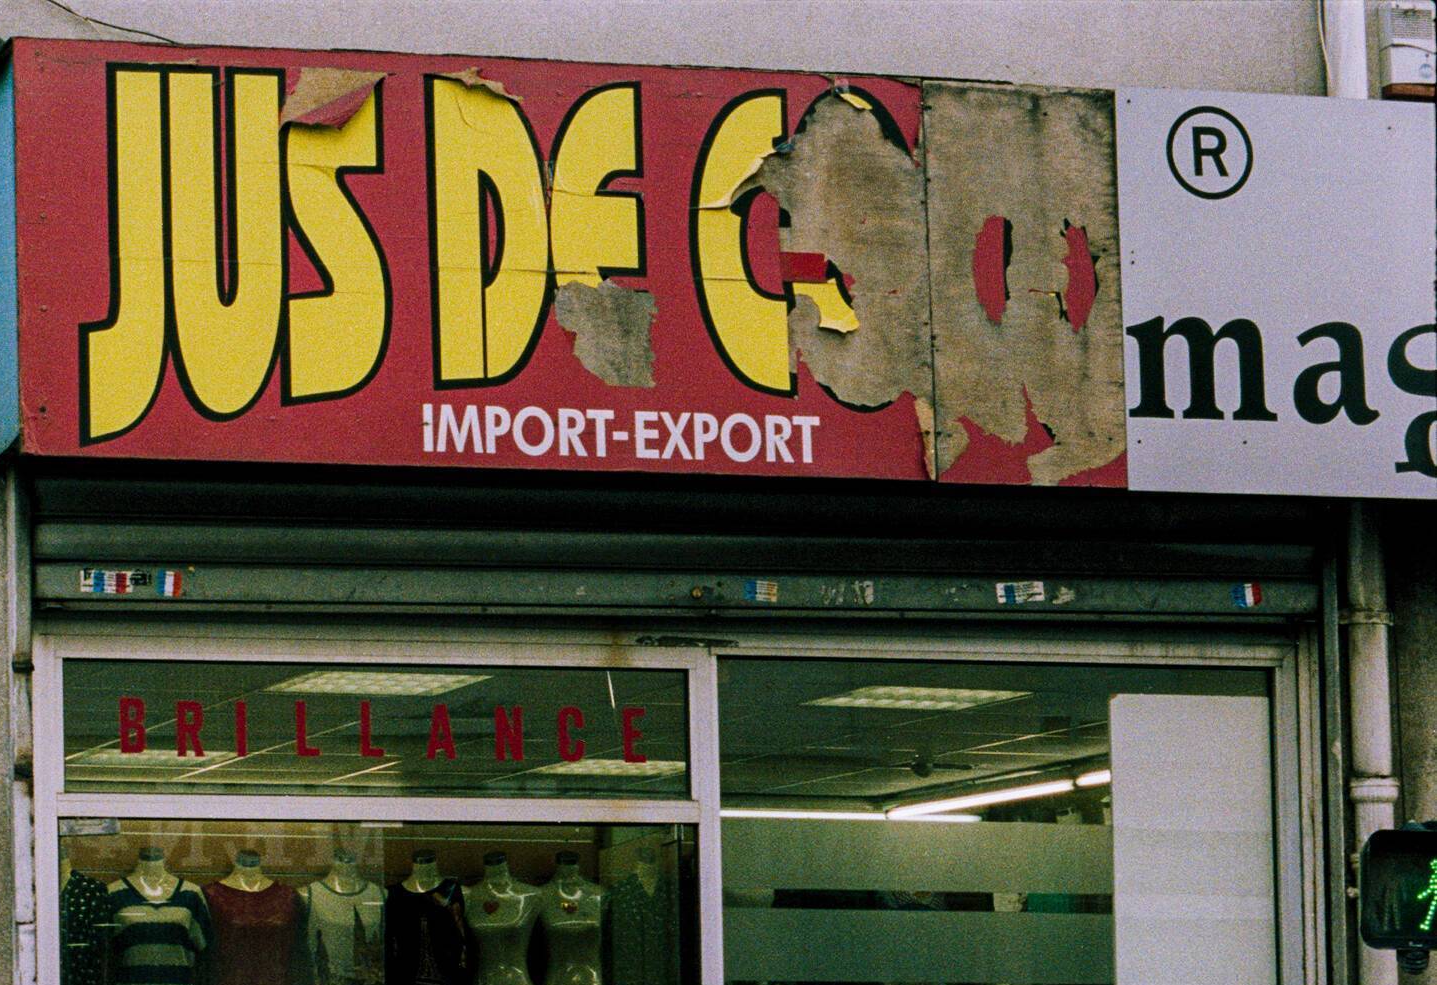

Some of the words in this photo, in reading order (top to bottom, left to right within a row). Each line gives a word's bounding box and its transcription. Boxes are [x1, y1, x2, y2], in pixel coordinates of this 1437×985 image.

[78, 61, 394, 448] JUS
[423, 72, 647, 391] DE
[422, 402, 821, 464] IMPORT-EXPORT
[118, 697, 648, 764] BRILLANCE
